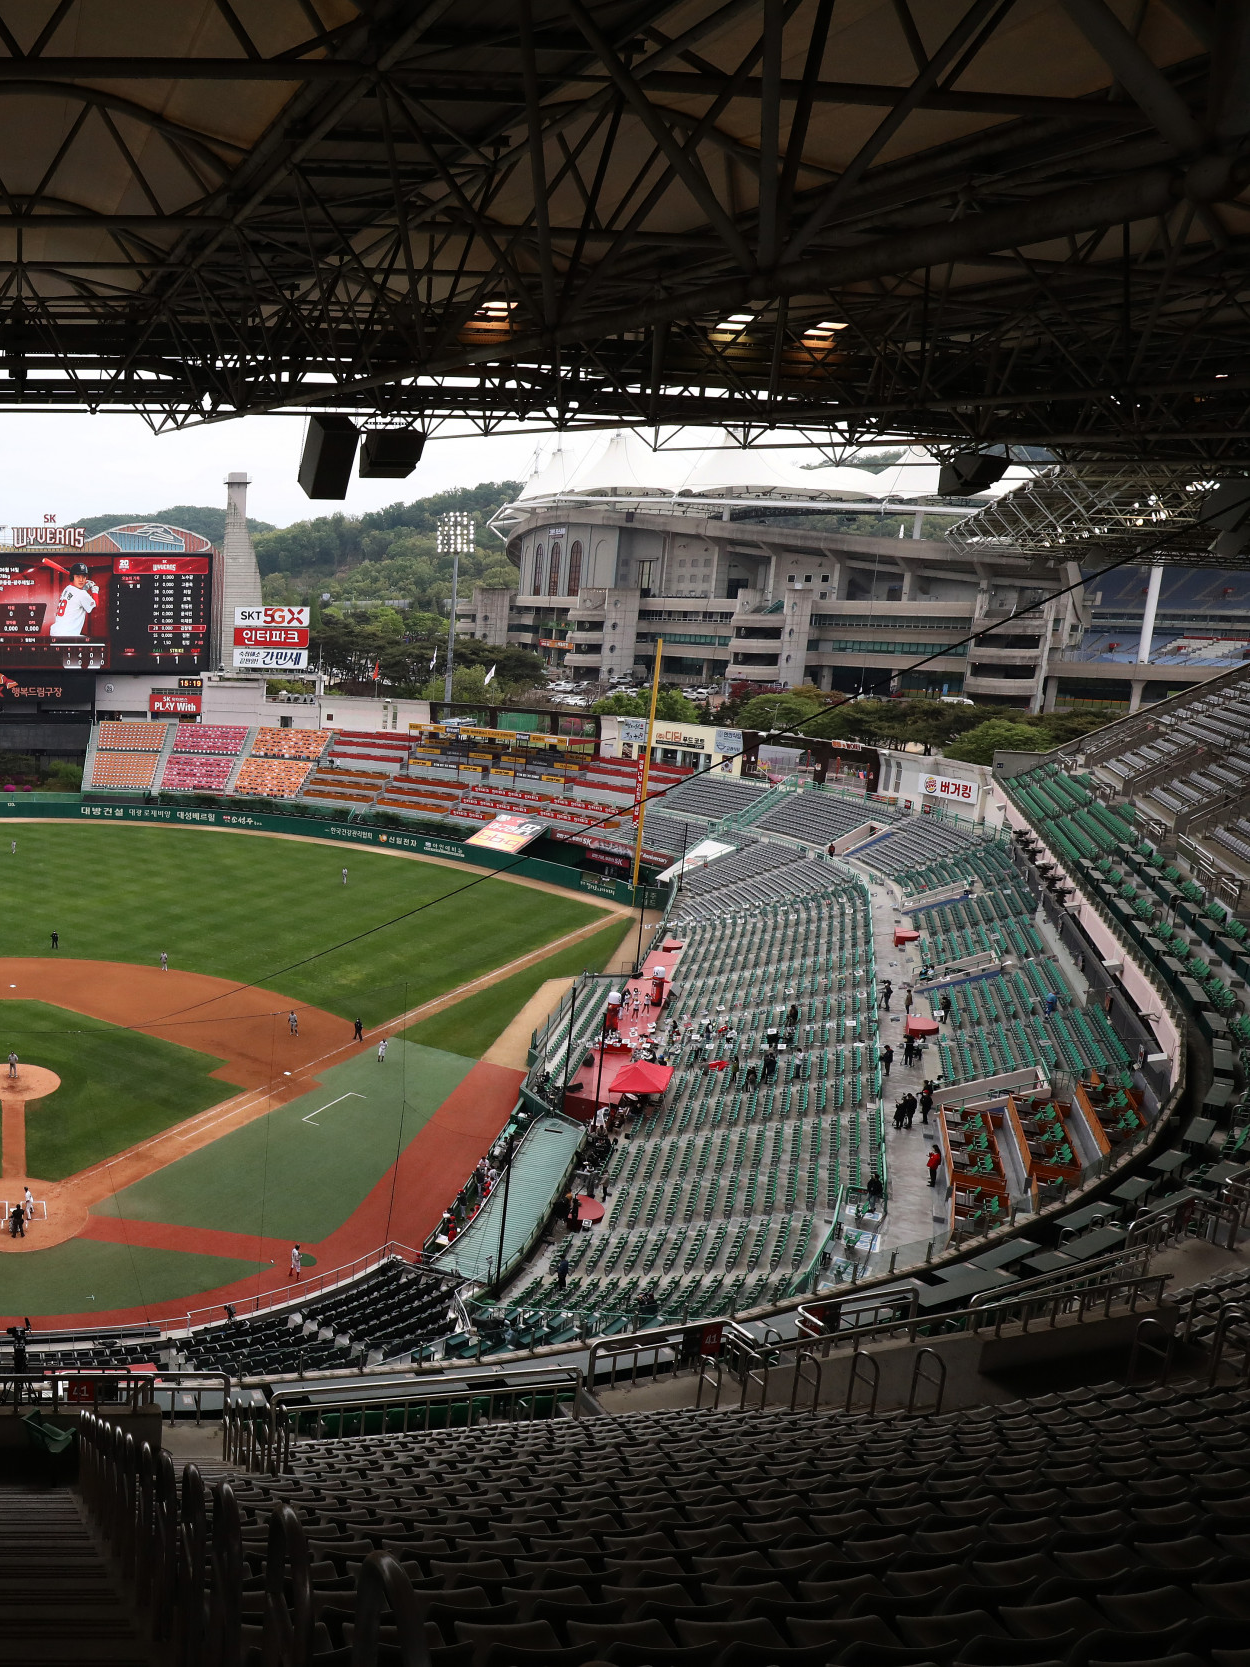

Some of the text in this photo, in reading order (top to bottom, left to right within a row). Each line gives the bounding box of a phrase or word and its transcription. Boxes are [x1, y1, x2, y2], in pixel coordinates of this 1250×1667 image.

[44, 514, 56, 524] SK
[11, 527, 86, 548] WYVERNS
[240, 608, 304, 625] SKT 5GX
[243, 630, 299, 644] 인터파크
[262, 652, 302, 666] 간만세
[11, 687, 62, 697] 행복드림구장
[177, 703, 196, 711] With
[940, 781, 972, 798] 버거킹
[80, 806, 124, 816] 대방건설
[177, 812, 215, 822] 대성베르힐
[231, 817, 254, 825] 소성주
[389, 837, 417, 847] 신일전자
[642, 853, 668, 864] Anniversary
[704, 1334, 718, 1345] 41
[72, 1385, 89, 1397] 41
